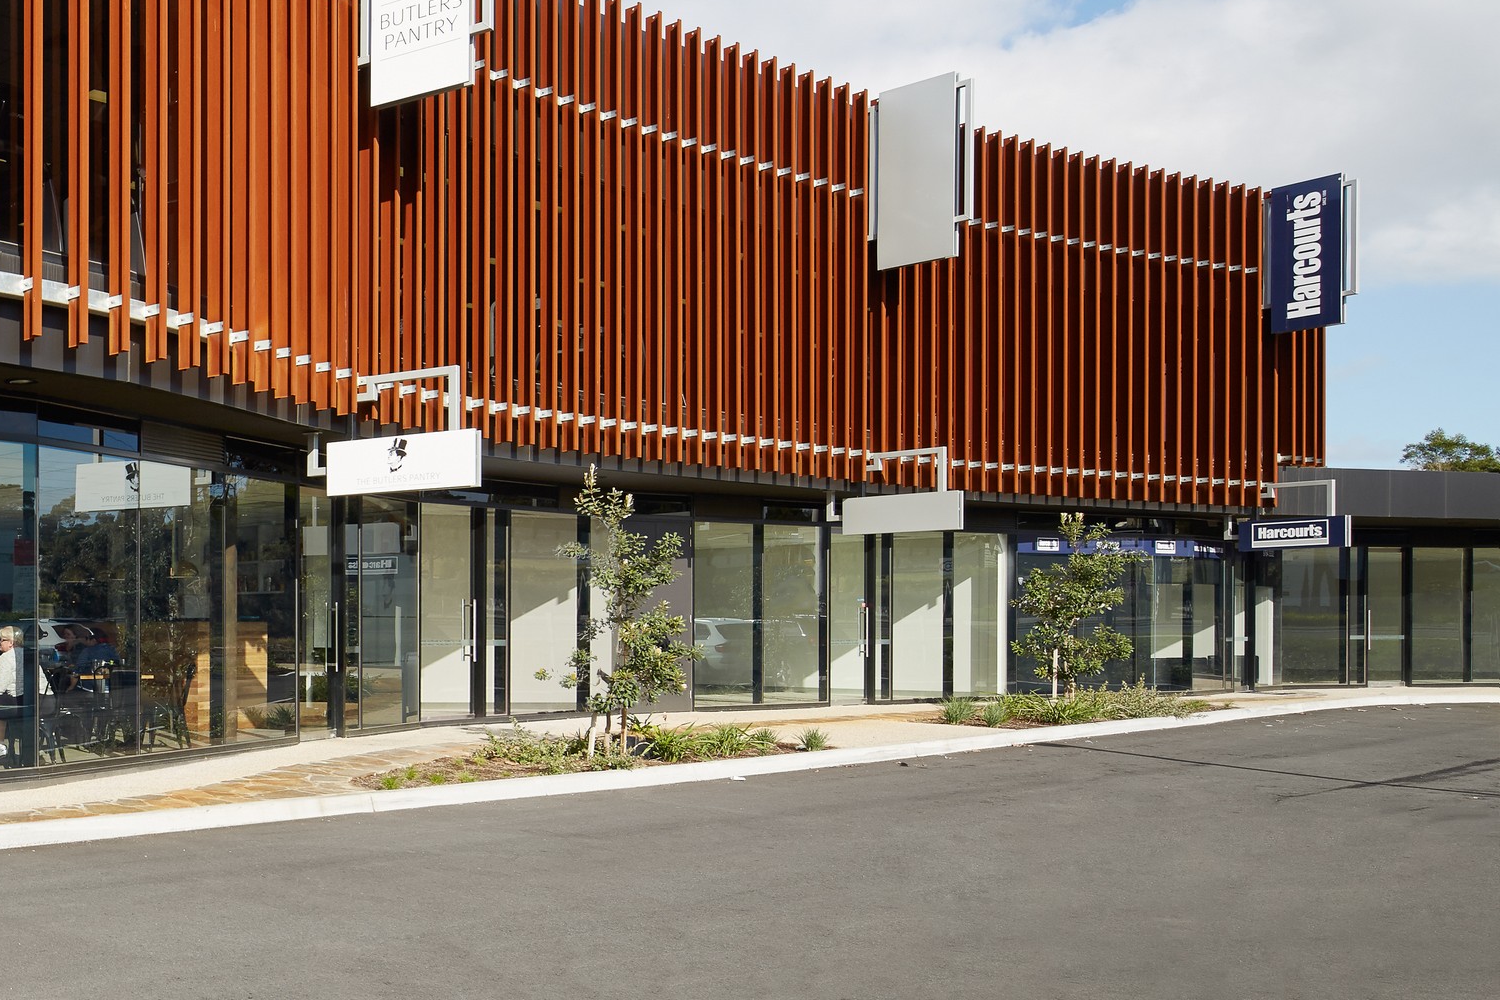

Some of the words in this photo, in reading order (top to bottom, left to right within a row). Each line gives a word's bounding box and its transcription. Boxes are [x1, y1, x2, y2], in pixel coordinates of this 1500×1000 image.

[384, 14, 458, 51] PANTRY
[1286, 191, 1322, 319] Harcourts
[356, 476, 371, 486] THE
[373, 473, 407, 485] BUTLERS
[409, 471, 441, 482] PANTRY
[1257, 524, 1323, 540] Harcourts
